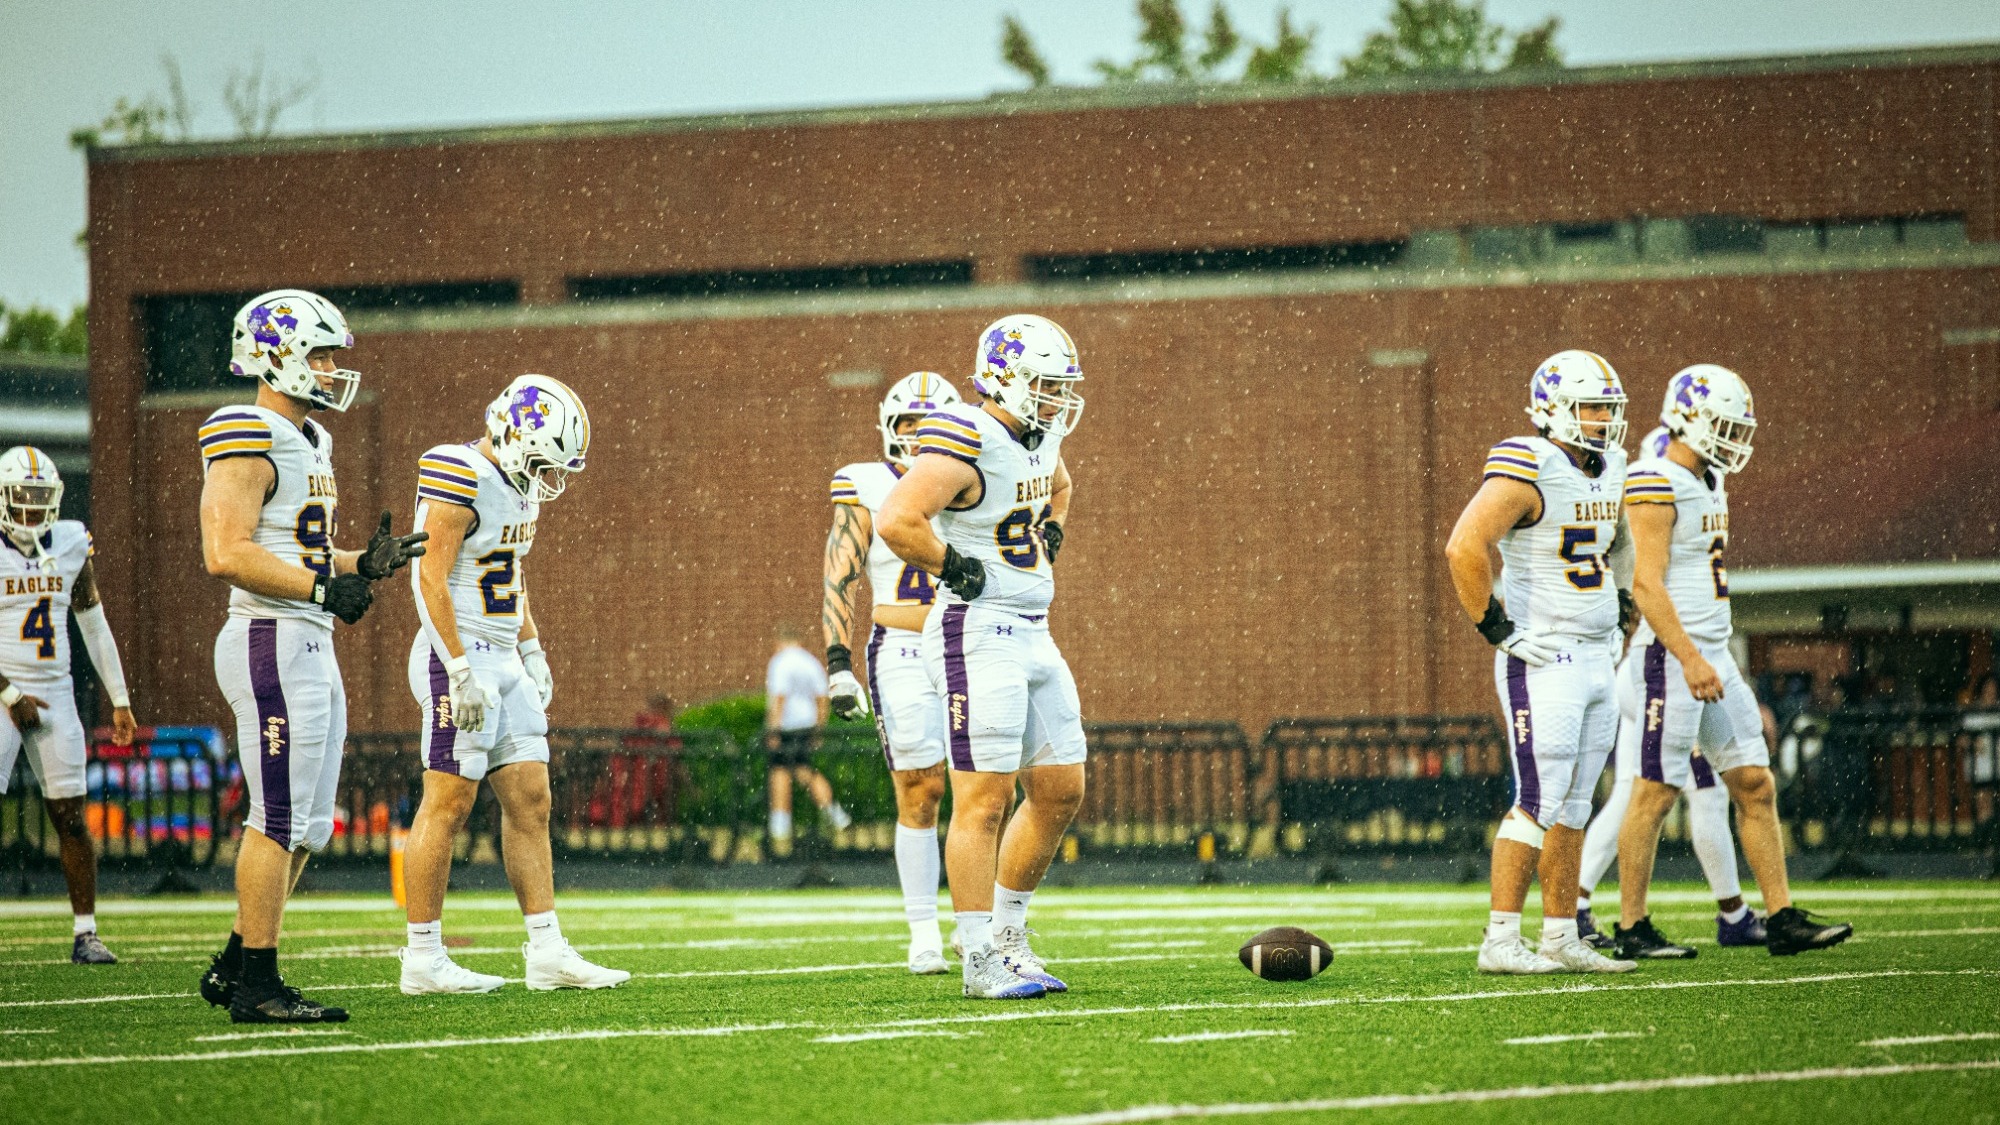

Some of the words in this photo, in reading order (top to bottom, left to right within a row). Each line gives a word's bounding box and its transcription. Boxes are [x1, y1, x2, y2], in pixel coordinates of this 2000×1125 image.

[1574, 501, 1617, 521] EAGLES
[293, 501, 339, 577] 9
[1558, 525, 1616, 592] 5
[5, 575, 63, 595] EAGLES
[20, 595, 56, 660] 4
[436, 694, 452, 729] Eagles
[950, 693, 967, 731] Eagles
[1514, 708, 1530, 745] Eagles
[263, 716, 286, 756] Eagles
